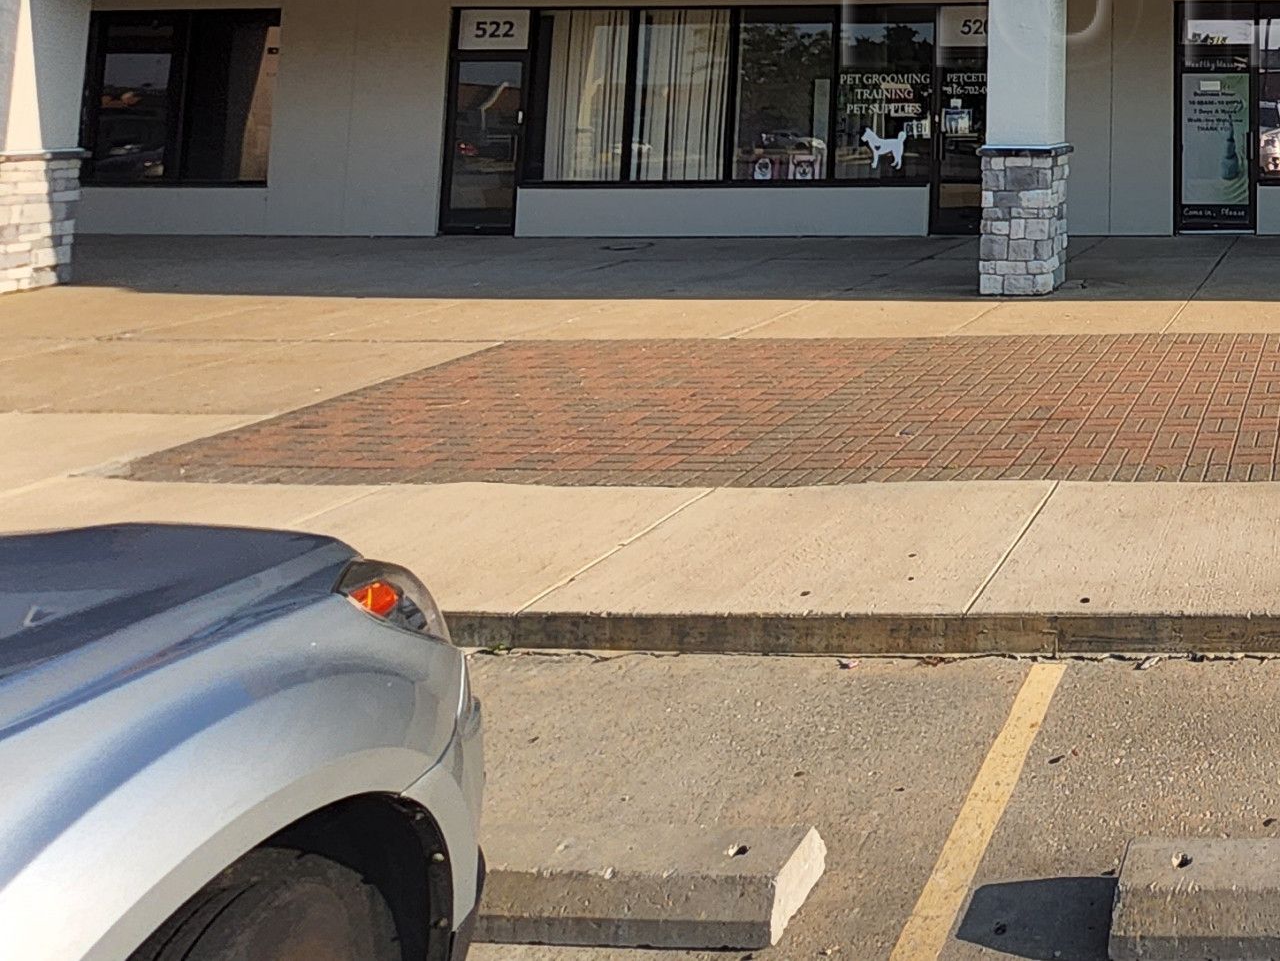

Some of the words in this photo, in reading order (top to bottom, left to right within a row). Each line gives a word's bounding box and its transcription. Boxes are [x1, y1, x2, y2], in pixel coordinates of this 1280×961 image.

[474, 20, 516, 39] 522
[840, 73, 862, 85] PET
[863, 73, 931, 85] GROOMING
[855, 88, 914, 100] TRAINING
[846, 103, 868, 115] PET
[868, 102, 922, 115] SUPPLIES
